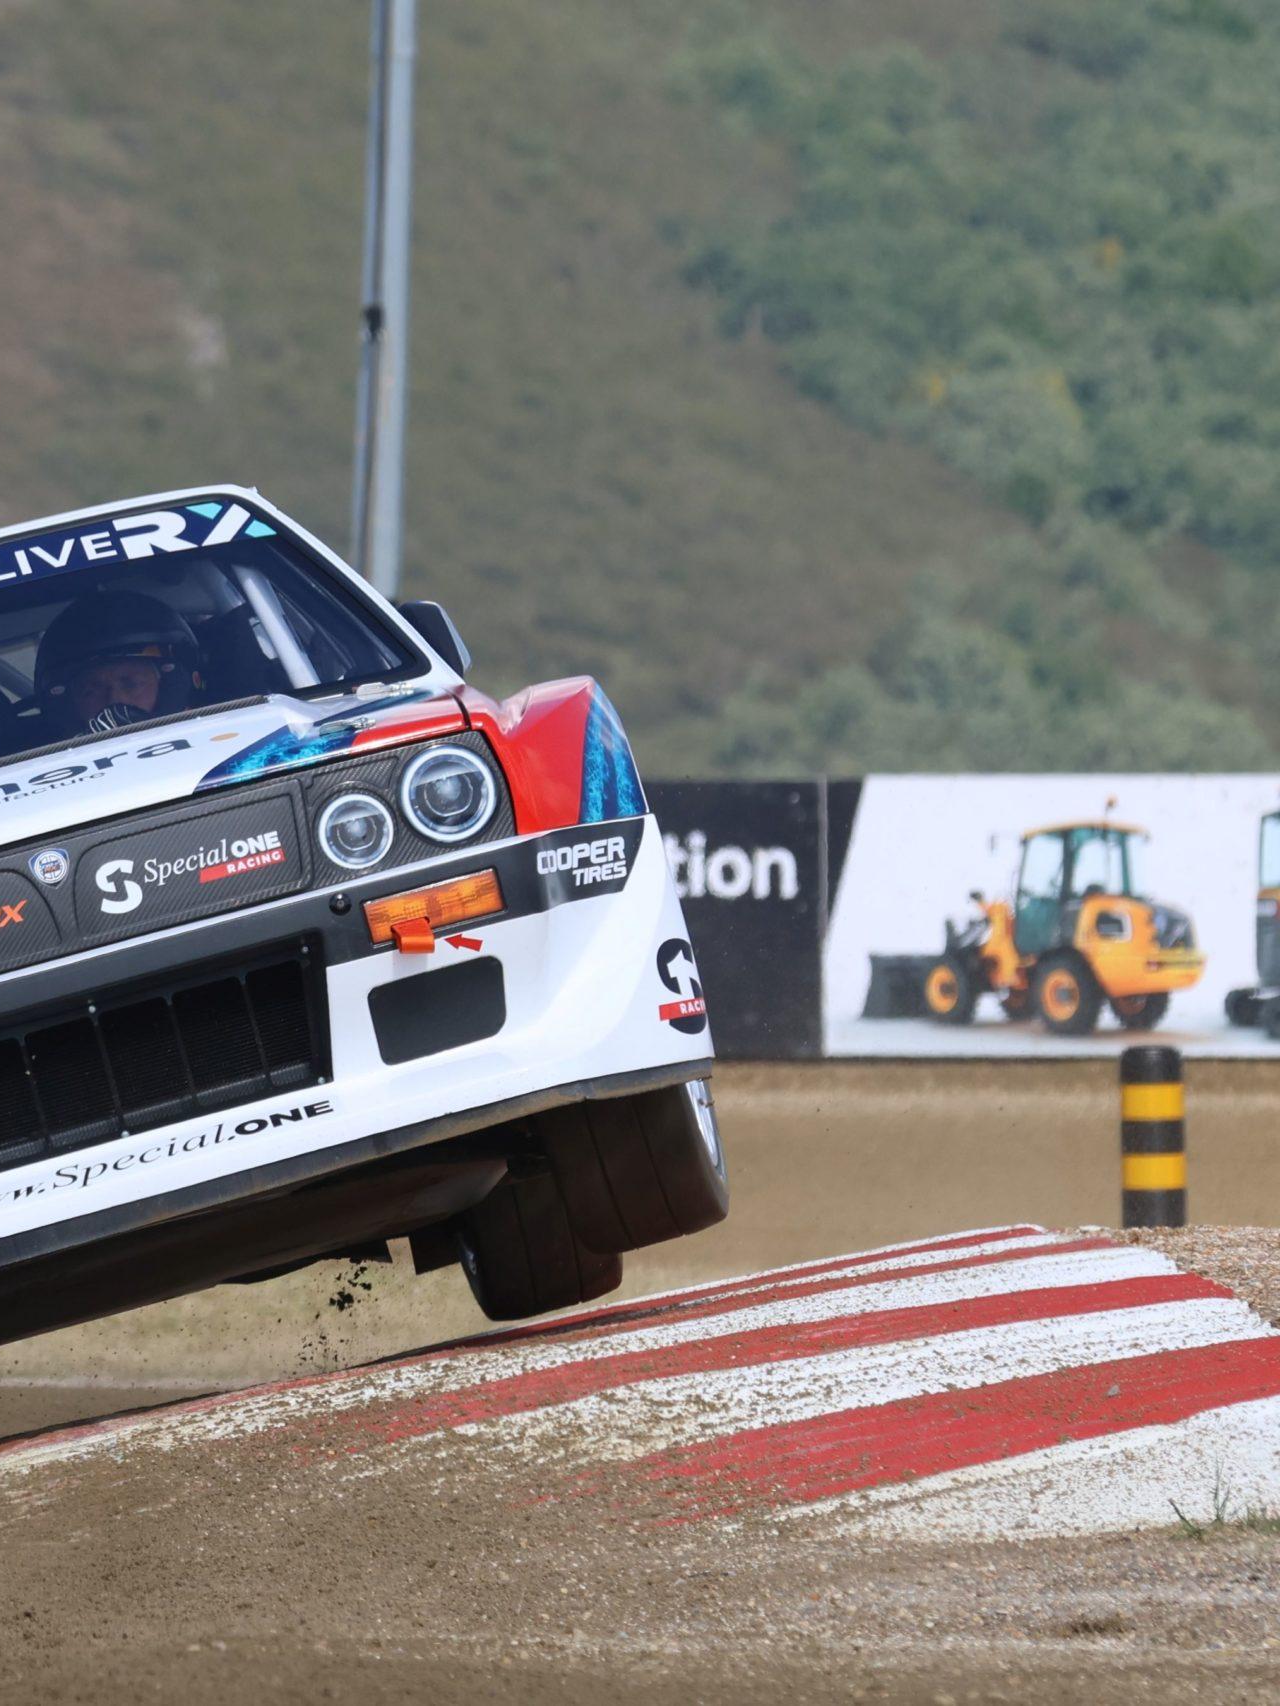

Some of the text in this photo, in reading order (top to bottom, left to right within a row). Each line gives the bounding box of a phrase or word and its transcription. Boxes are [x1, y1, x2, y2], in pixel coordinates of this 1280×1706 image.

[112, 502, 277, 561] RX
[226, 852, 282, 874] RACING
[537, 836, 625, 875] COOPER
[662, 829, 799, 900] tion
[572, 860, 627, 886] TIRES
[679, 1000, 706, 1015] RACI
